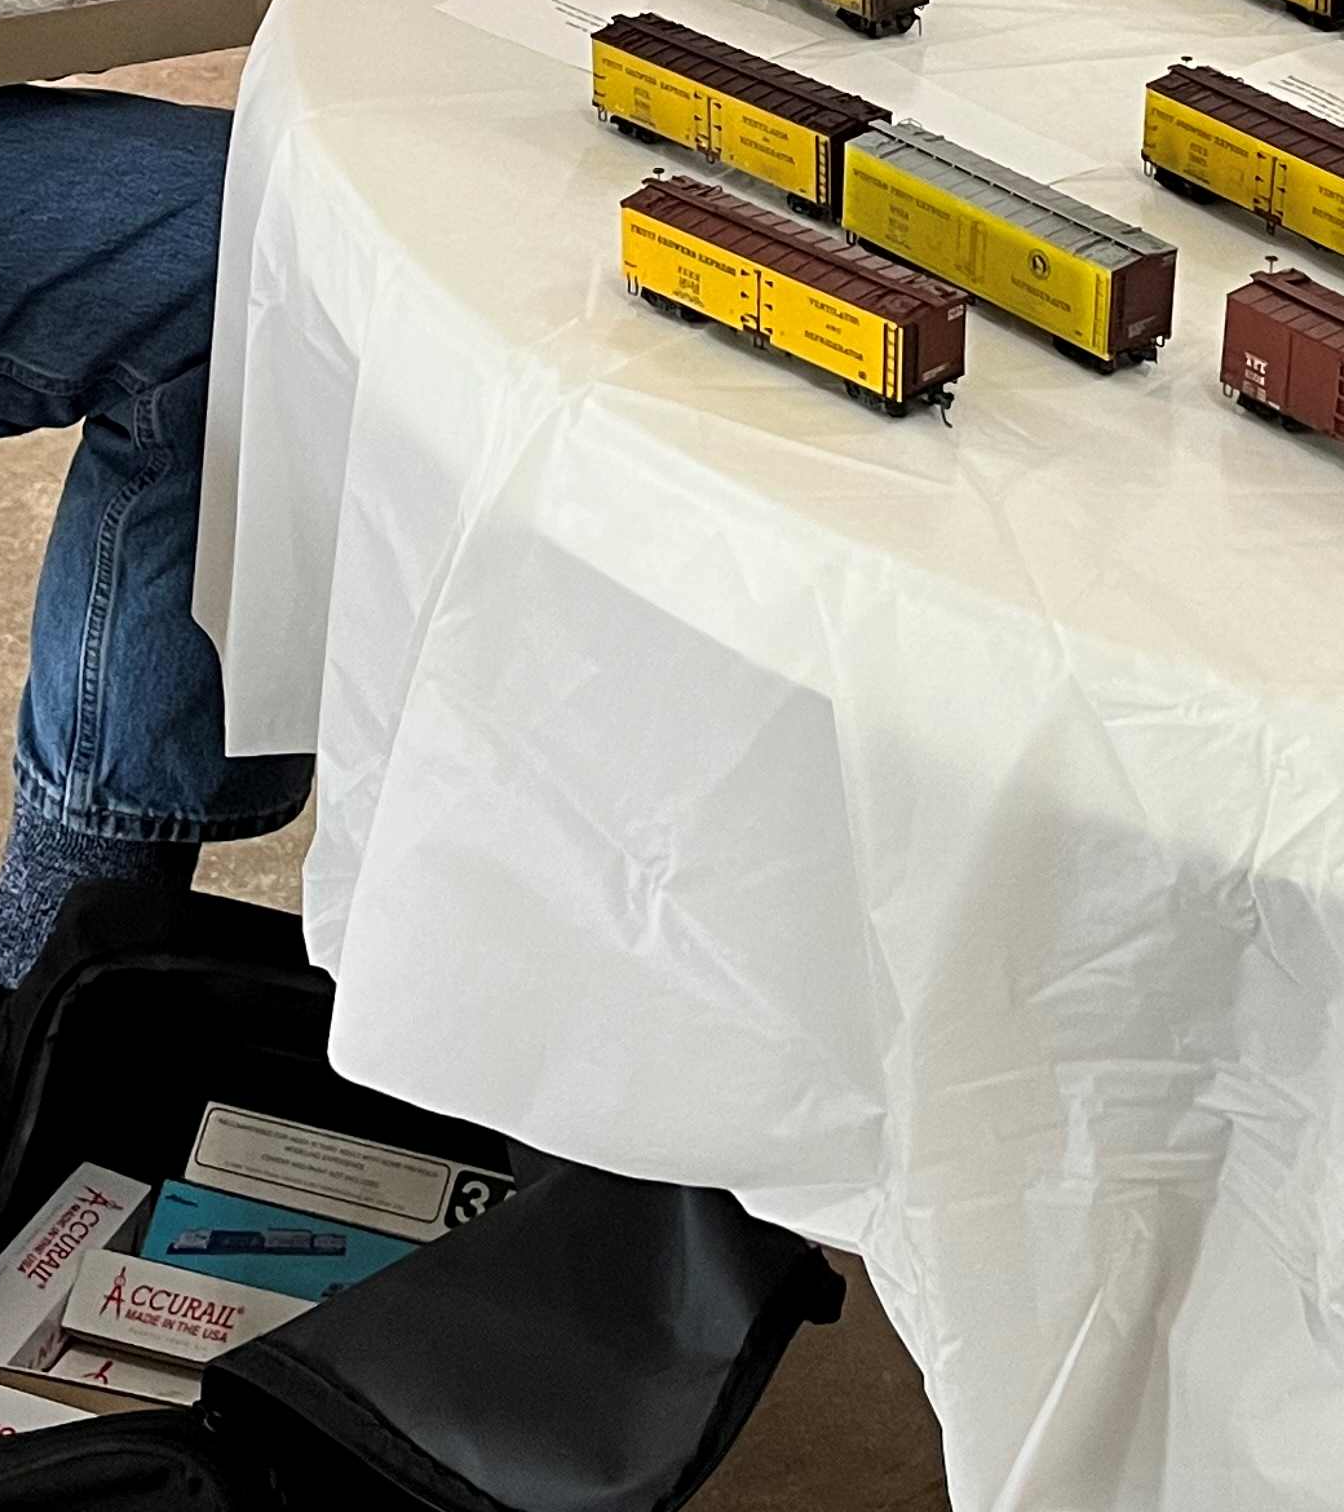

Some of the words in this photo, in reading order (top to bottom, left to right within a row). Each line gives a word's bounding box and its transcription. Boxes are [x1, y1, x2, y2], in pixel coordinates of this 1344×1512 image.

[455, 1180, 491, 1224] 3
[28, 1185, 124, 1284] ACCURAIL
[98, 1265, 237, 1330] ACCURAIL
[125, 1309, 160, 1327] MADE
[161, 1318, 175, 1331] IN
[176, 1321, 202, 1337] THE
[202, 1327, 228, 1344] USA
